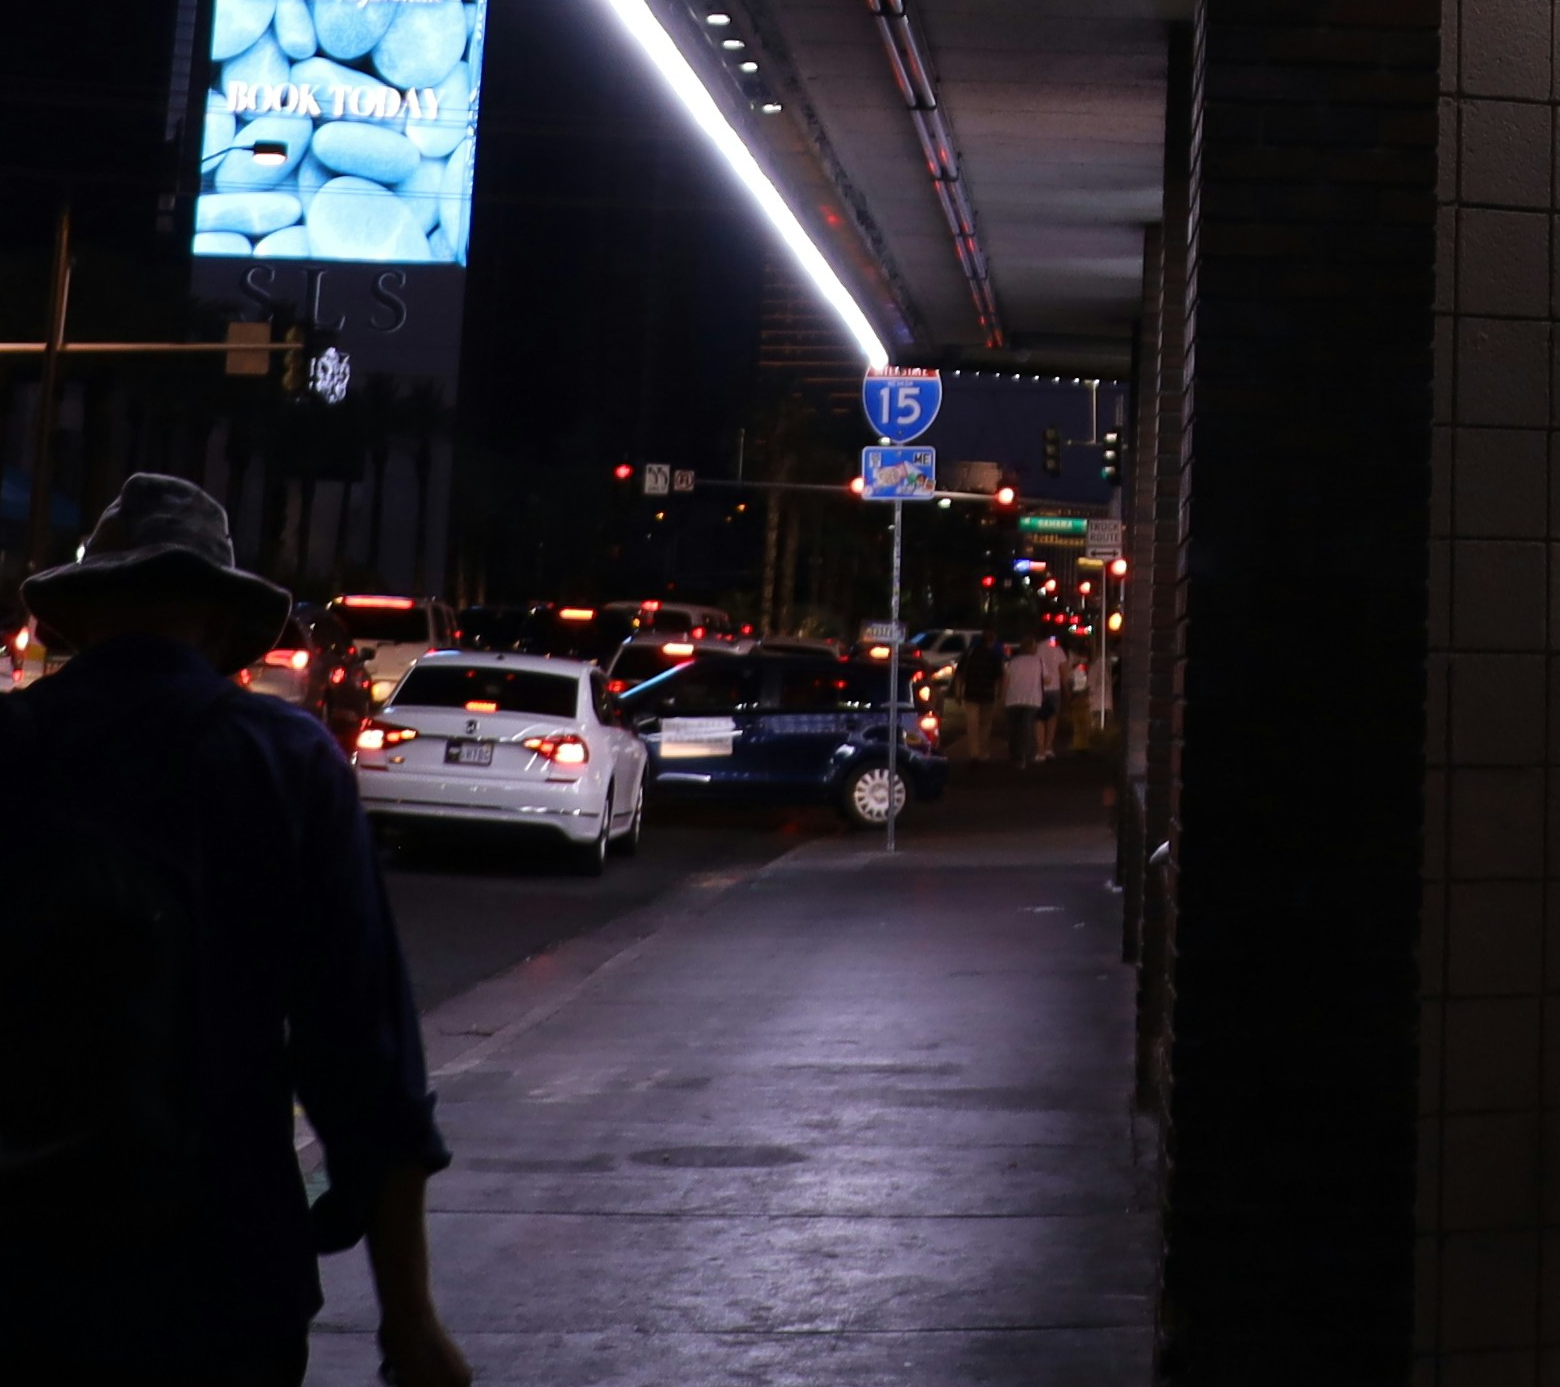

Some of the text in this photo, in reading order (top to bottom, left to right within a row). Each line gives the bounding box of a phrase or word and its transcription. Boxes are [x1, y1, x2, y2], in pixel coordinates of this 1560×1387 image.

[226, 80, 448, 120] BOOK TODAY
[879, 386, 922, 425] 15
